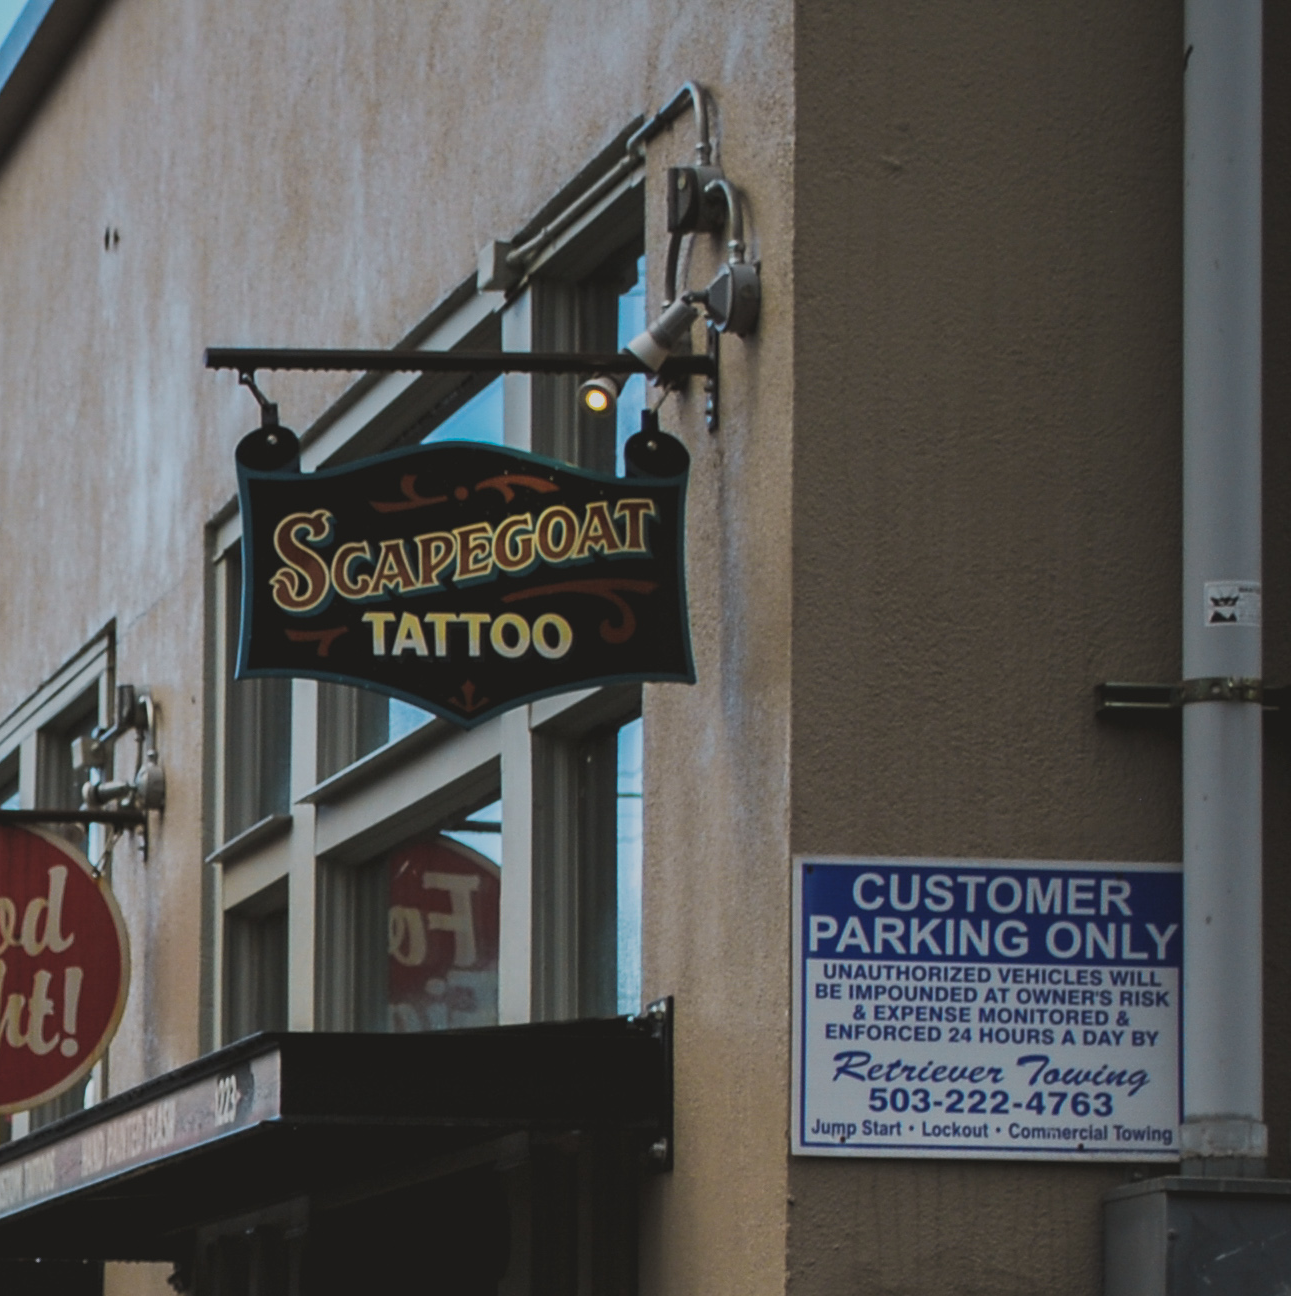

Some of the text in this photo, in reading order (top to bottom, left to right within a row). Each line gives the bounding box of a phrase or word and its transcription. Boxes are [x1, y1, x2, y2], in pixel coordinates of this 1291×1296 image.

[269, 498, 656, 614] SCAPEGOAT
[361, 610, 573, 660] TATTOO
[852, 872, 1133, 917] CUSTOMER
[808, 914, 1178, 960] PARKING ONLY
[823, 963, 1163, 987] UNAUTHORIZED VEHICLES WILL
[815, 982, 1170, 1007] BE IMPOUNDED AT OWNER'S RISK
[852, 1003, 1130, 1026] & EXPENSE MONITORED &
[824, 1023, 1160, 1047] ENFORCED 24 HOURS A DAY BY
[831, 1050, 1151, 1097] Retriever Towing
[867, 1087, 1114, 1117] 503-222-4763
[811, 1119, 1172, 1145] Jump Start Lockout Commercial Towing
